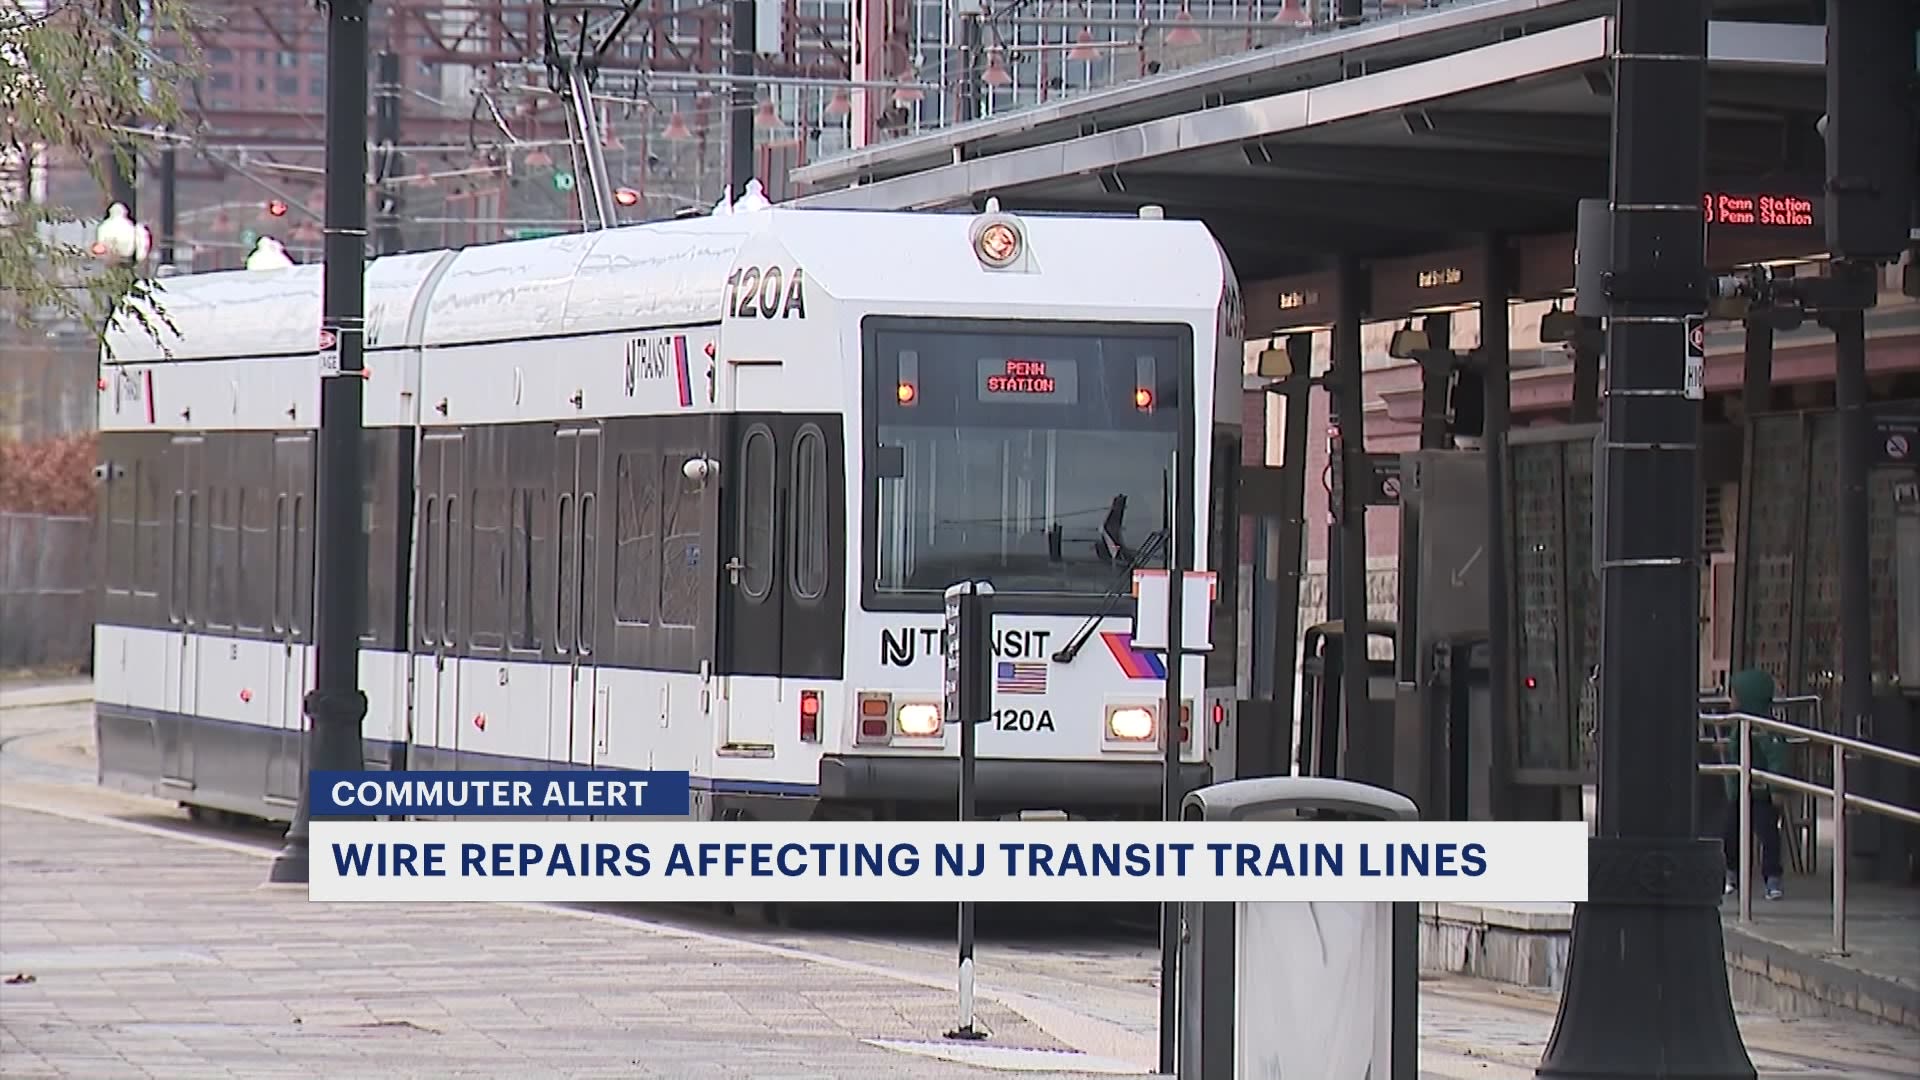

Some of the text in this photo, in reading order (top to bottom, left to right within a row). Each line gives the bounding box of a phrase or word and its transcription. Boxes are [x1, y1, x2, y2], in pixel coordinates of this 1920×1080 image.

[1719, 195, 1753, 211] Penn
[1760, 196, 1811, 212] Station
[1720, 209, 1813, 225] Penn Station
[727, 265, 806, 320] 120A
[1006, 361, 1045, 376] PENN
[988, 377, 1053, 392] STATION
[880, 628, 1051, 668] NJ TNSIT
[992, 709, 1056, 732] 120A
